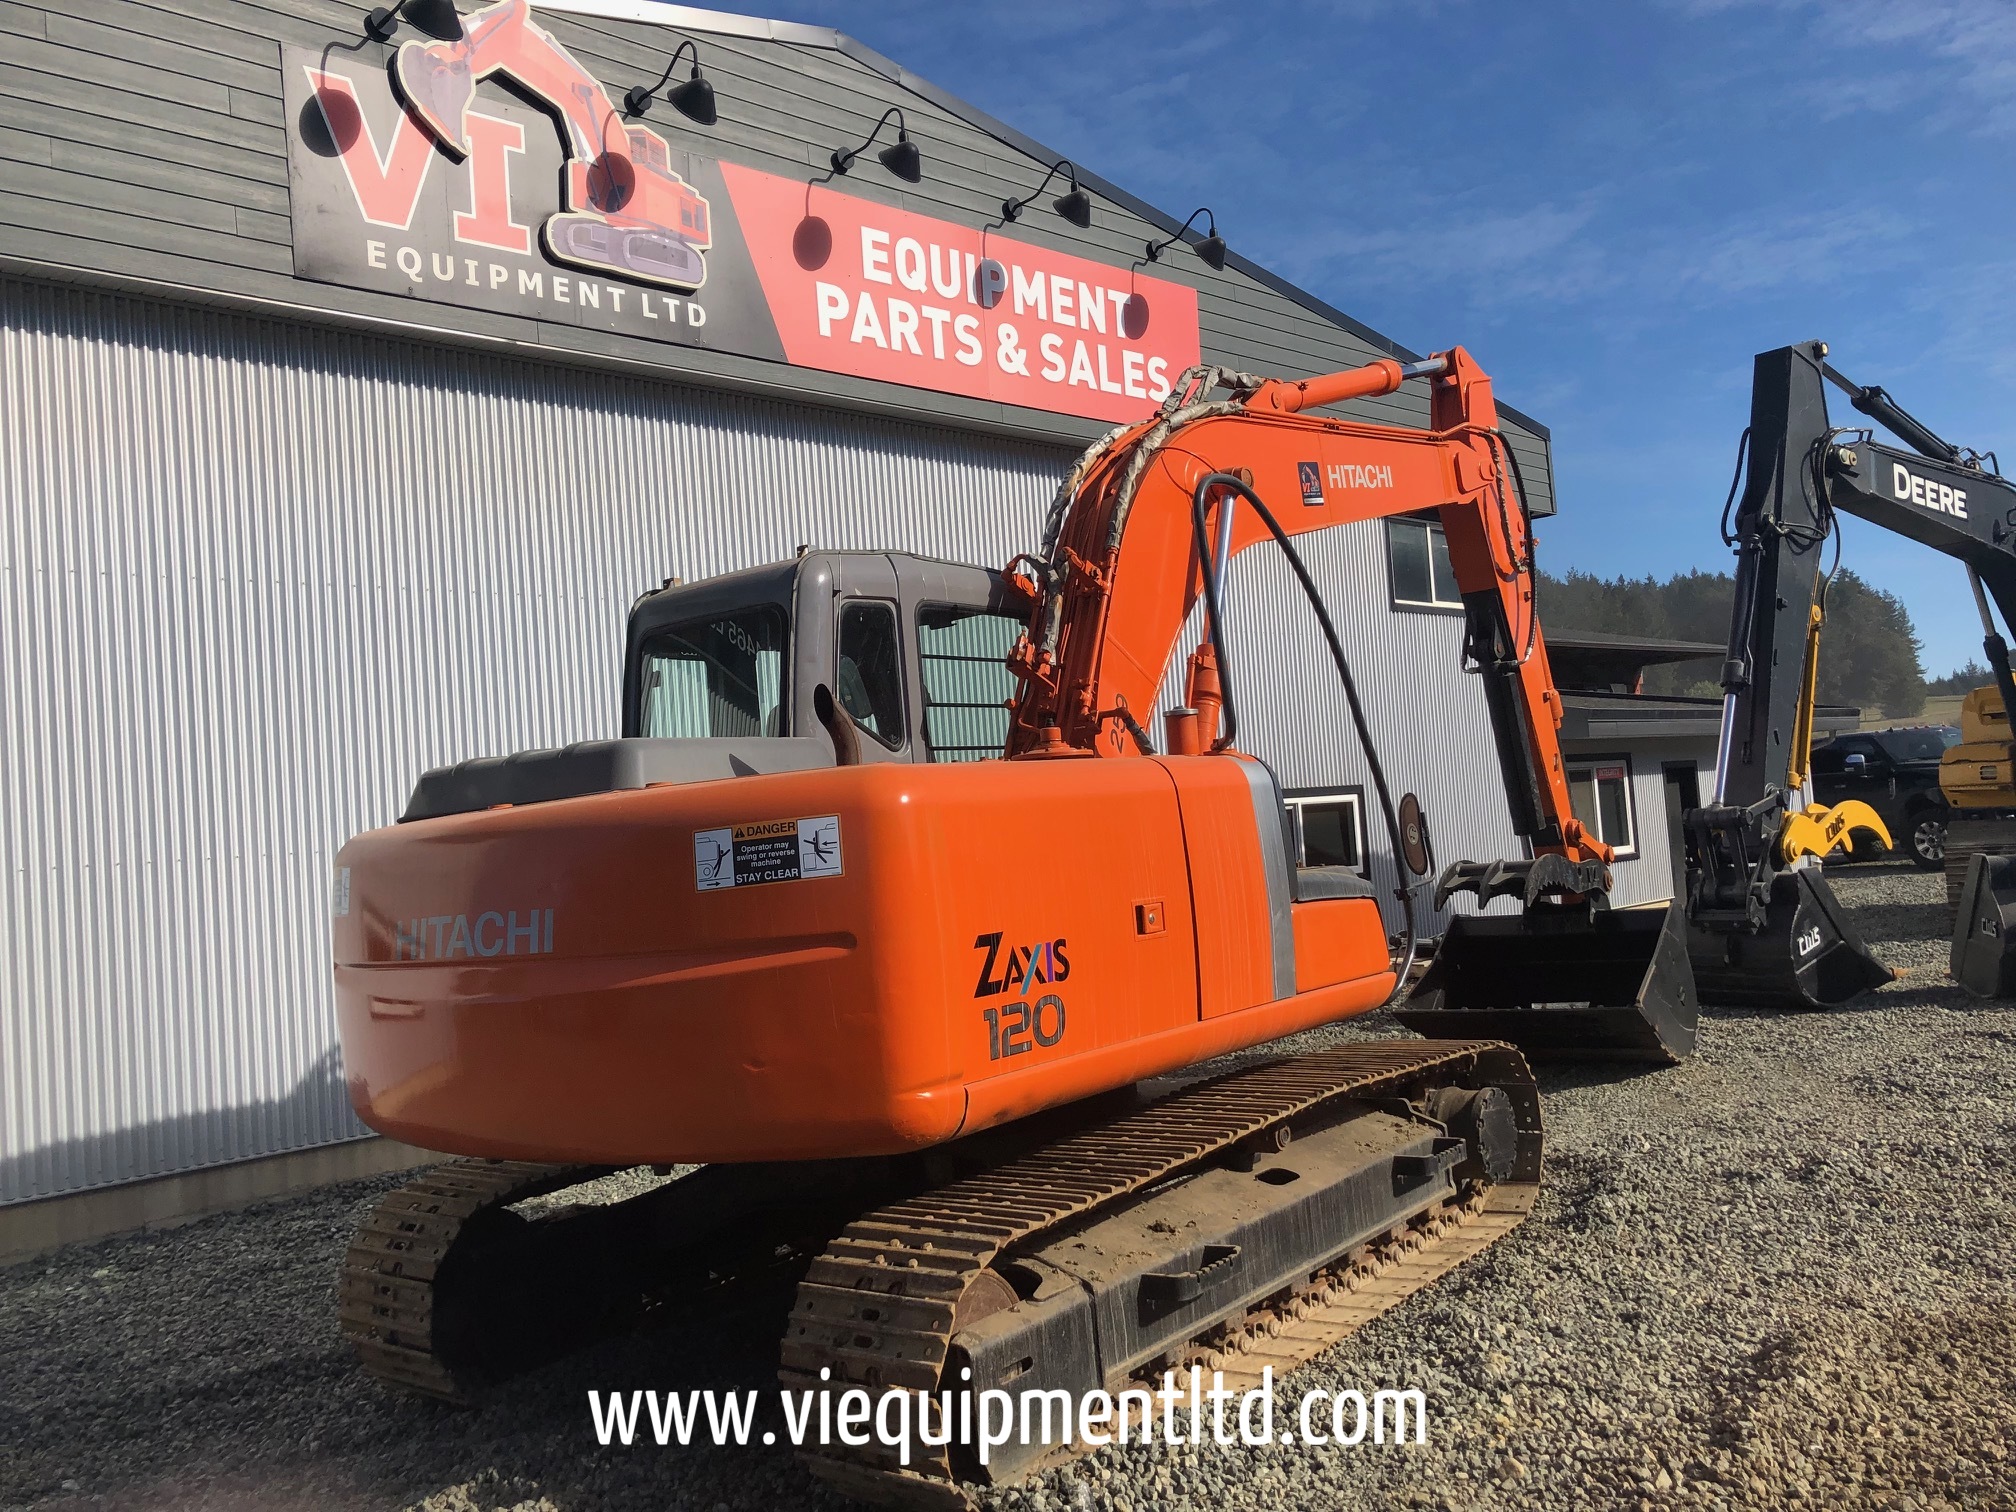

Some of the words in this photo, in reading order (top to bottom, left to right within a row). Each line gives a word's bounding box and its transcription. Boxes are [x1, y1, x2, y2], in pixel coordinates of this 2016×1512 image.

[302, 65, 531, 256] VI
[366, 239, 626, 313] EQUIPMENT
[641, 293, 707, 328] LTD
[860, 225, 1132, 339] EQUIPMENT
[815, 280, 983, 367] PARTS
[996, 321, 1031, 377] &
[1039, 332, 1171, 403] SALES
[1326, 464, 1394, 489] HITACHI
[1892, 462, 1968, 519] DEERE
[736, 852, 758, 862] swing
[768, 848, 796, 858] reverse
[740, 843, 773, 854] Operator
[773, 841, 790, 850] may
[746, 821, 796, 837] DANGER
[736, 871, 762, 884] STAY
[764, 868, 799, 880] CLEAR
[750, 858, 782, 868] machine
[396, 908, 555, 961] HITACHI
[973, 931, 1071, 999] ZAXIS
[983, 993, 1066, 1062] 120
